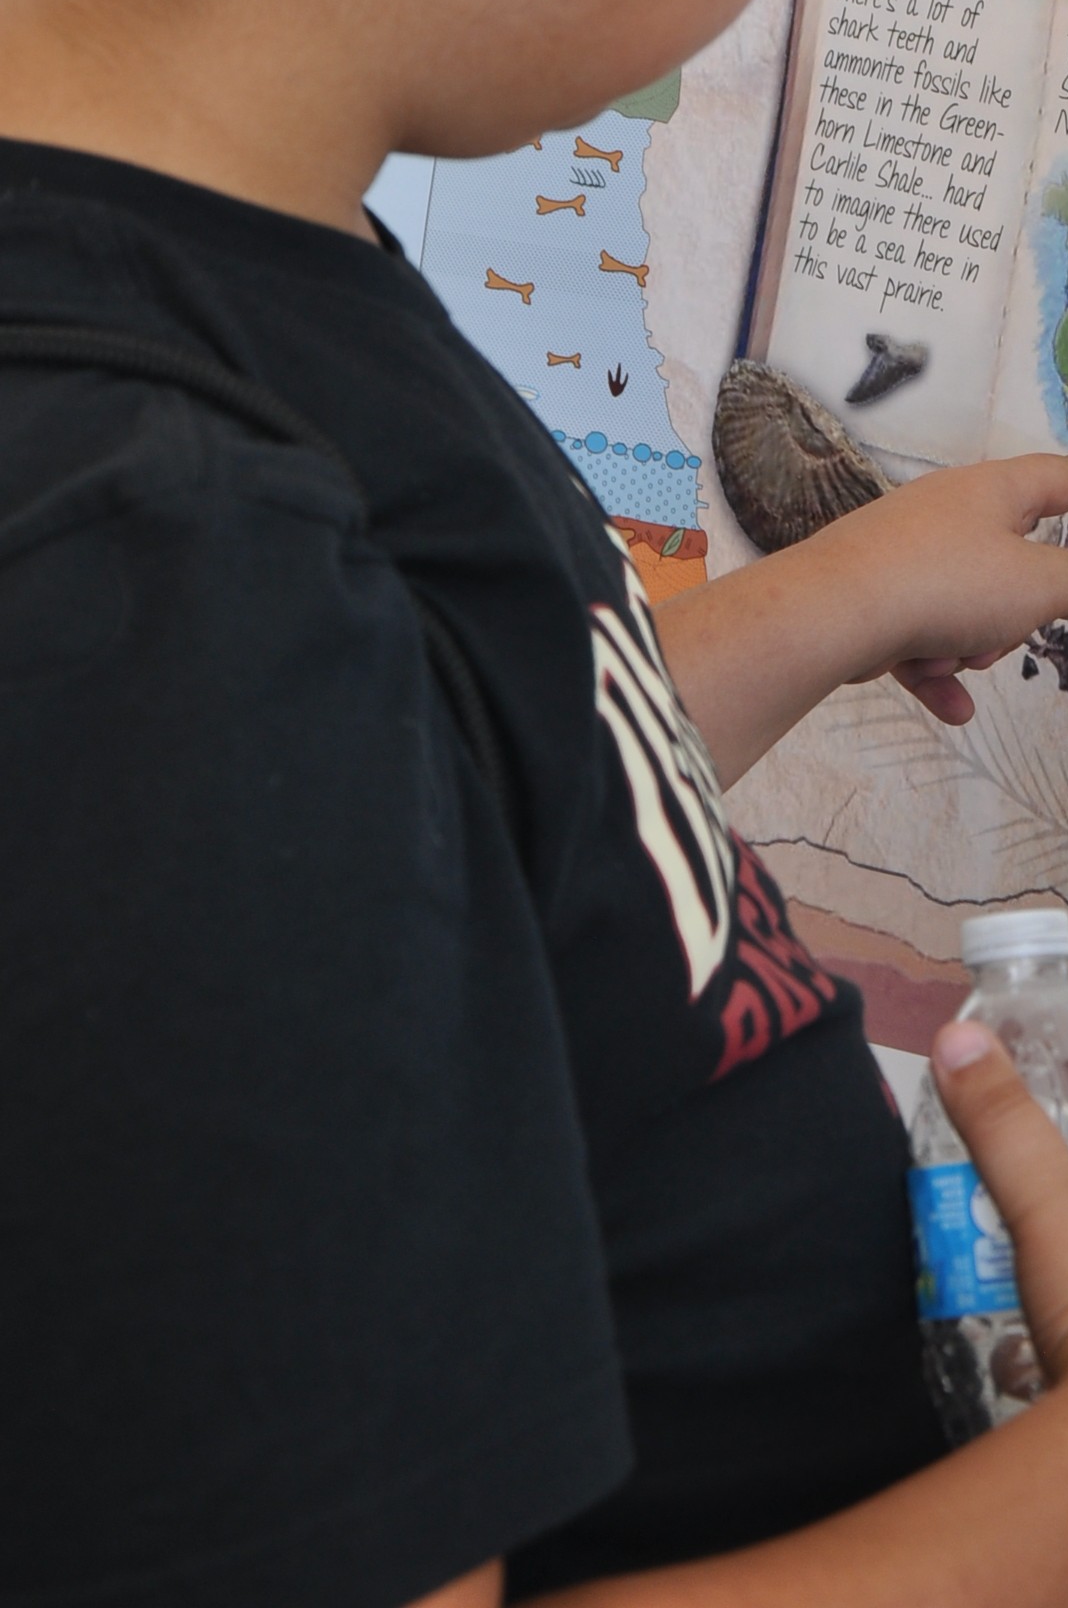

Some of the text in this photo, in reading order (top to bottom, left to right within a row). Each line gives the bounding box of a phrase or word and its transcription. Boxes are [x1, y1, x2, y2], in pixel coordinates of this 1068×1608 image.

[827, 7, 980, 66] shark teeth and
[960, 0, 985, 30] of
[819, 77, 1005, 142] these in the Green-
[823, 49, 1012, 109] ammonite fossils like
[814, 106, 998, 178] horn Limestone and
[809, 142, 988, 212] Carlile Shale... hard
[799, 212, 980, 284] to be a sea here in
[804, 178, 1005, 253] to imagine there used
[794, 245, 943, 314] this vast prairie.
